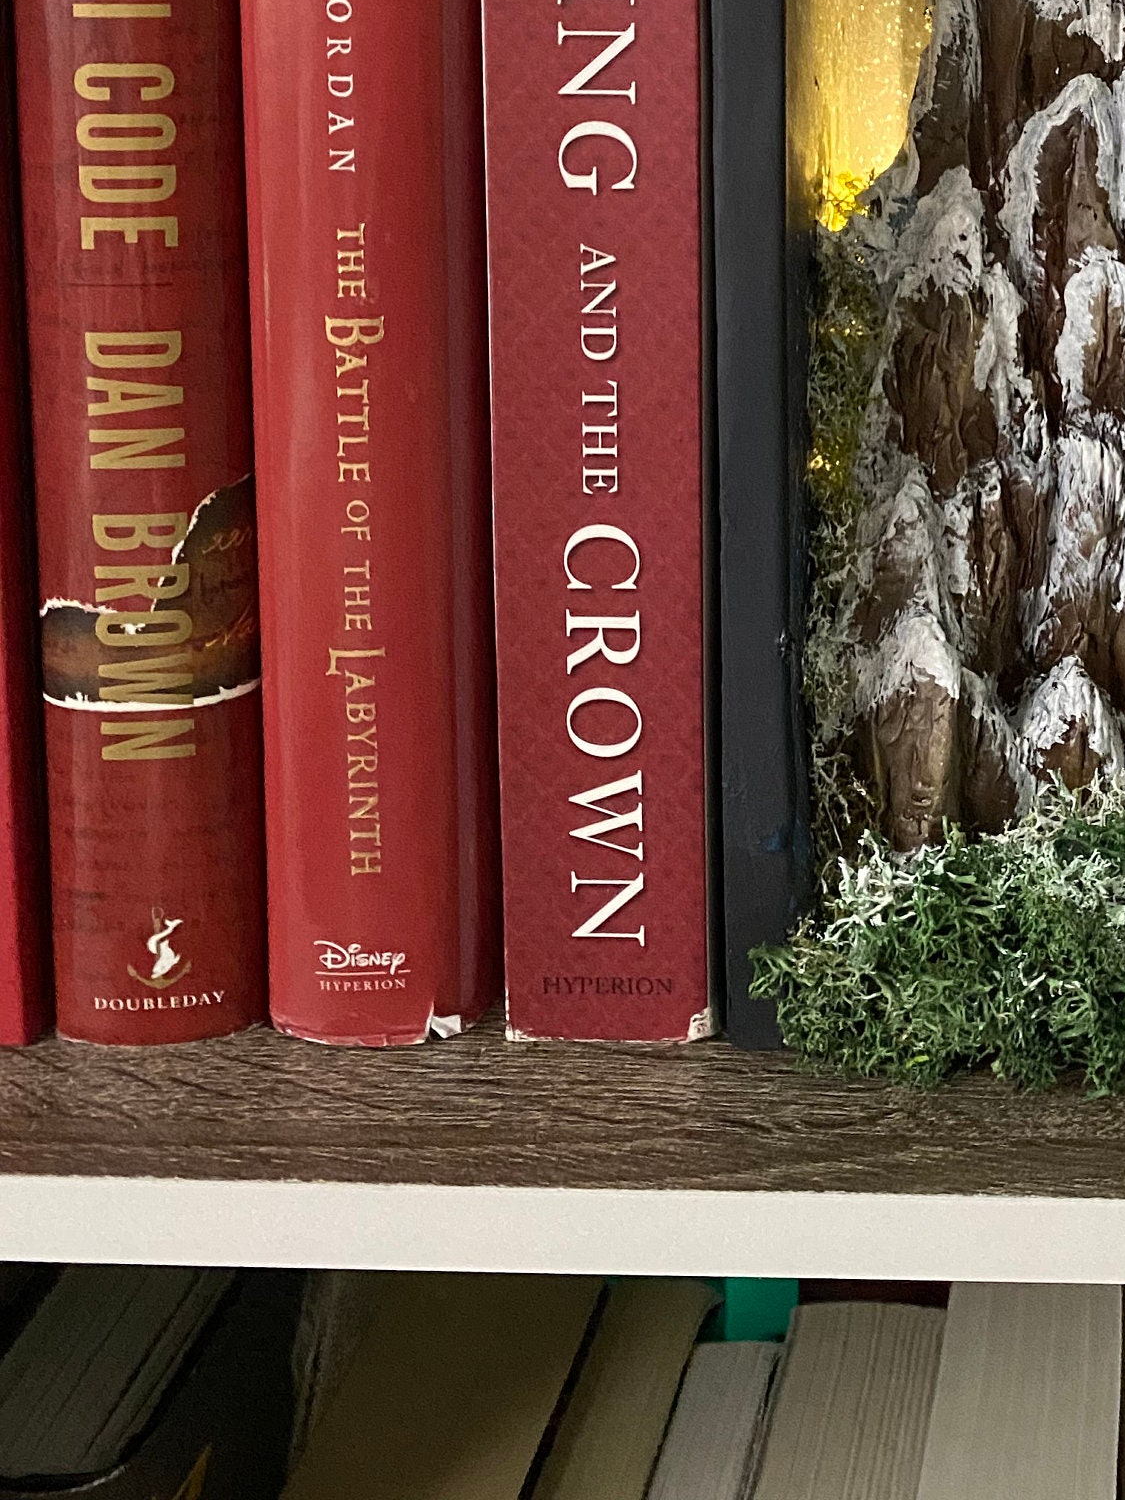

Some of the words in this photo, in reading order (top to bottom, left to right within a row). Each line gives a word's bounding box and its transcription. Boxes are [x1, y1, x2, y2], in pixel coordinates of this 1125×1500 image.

[73, 63, 179, 250] CODE
[336, 223, 367, 299] THE
[580, 243, 619, 362] AND
[85, 330, 186, 469] DAN
[325, 315, 385, 483] BATTLE
[581, 380, 619, 495] THE
[341, 499, 372, 542] OF
[92, 512, 196, 761] BROWN
[343, 560, 373, 631] THE
[326, 647, 386, 876] LABYRINTH
[563, 523, 646, 949] CROWN
[93, 989, 226, 1011] DOUBLEDAY
[319, 978, 406, 992] HYPERION
[543, 976, 674, 996] HYPERION
